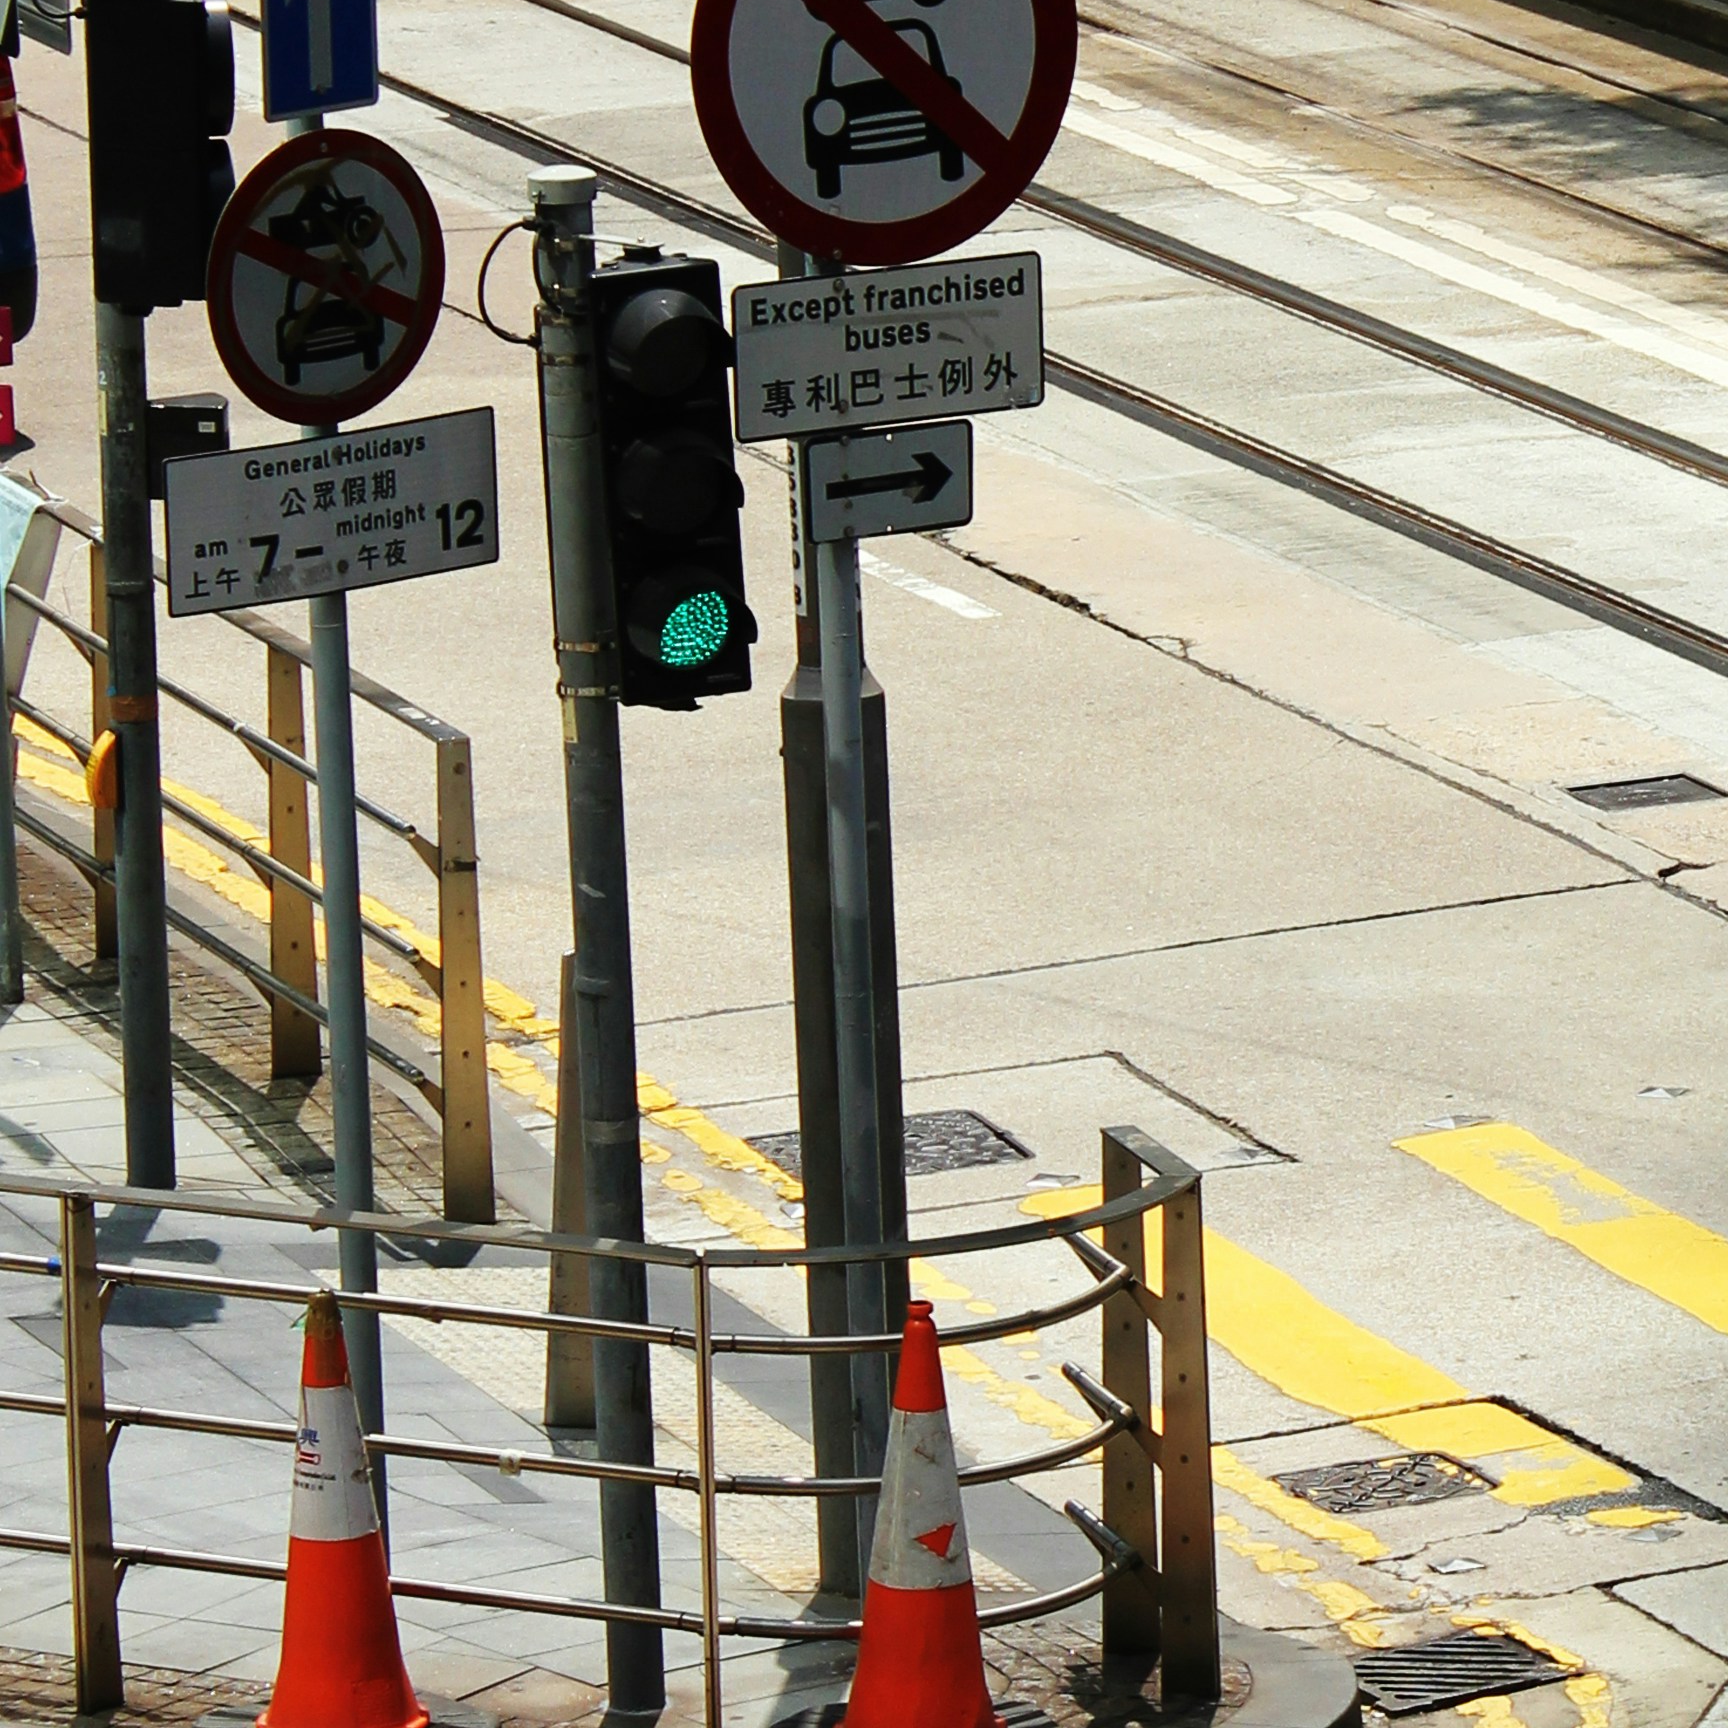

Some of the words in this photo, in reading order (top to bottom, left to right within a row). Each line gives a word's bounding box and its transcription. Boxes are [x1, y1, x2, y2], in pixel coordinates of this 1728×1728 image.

[750, 287, 855, 327] Except
[863, 268, 1025, 314] franchised
[845, 321, 931, 352] buses
[762, 351, 1019, 419] 專利巴士例外
[244, 449, 330, 480] General
[336, 433, 426, 466] Holidays
[279, 469, 398, 518] 公眾假期
[194, 538, 228, 559] am
[249, 533, 280, 583] 7
[336, 502, 426, 537] midnight
[436, 498, 486, 551] 12
[357, 538, 408, 572] 午夜
[185, 567, 241, 600] 上午
